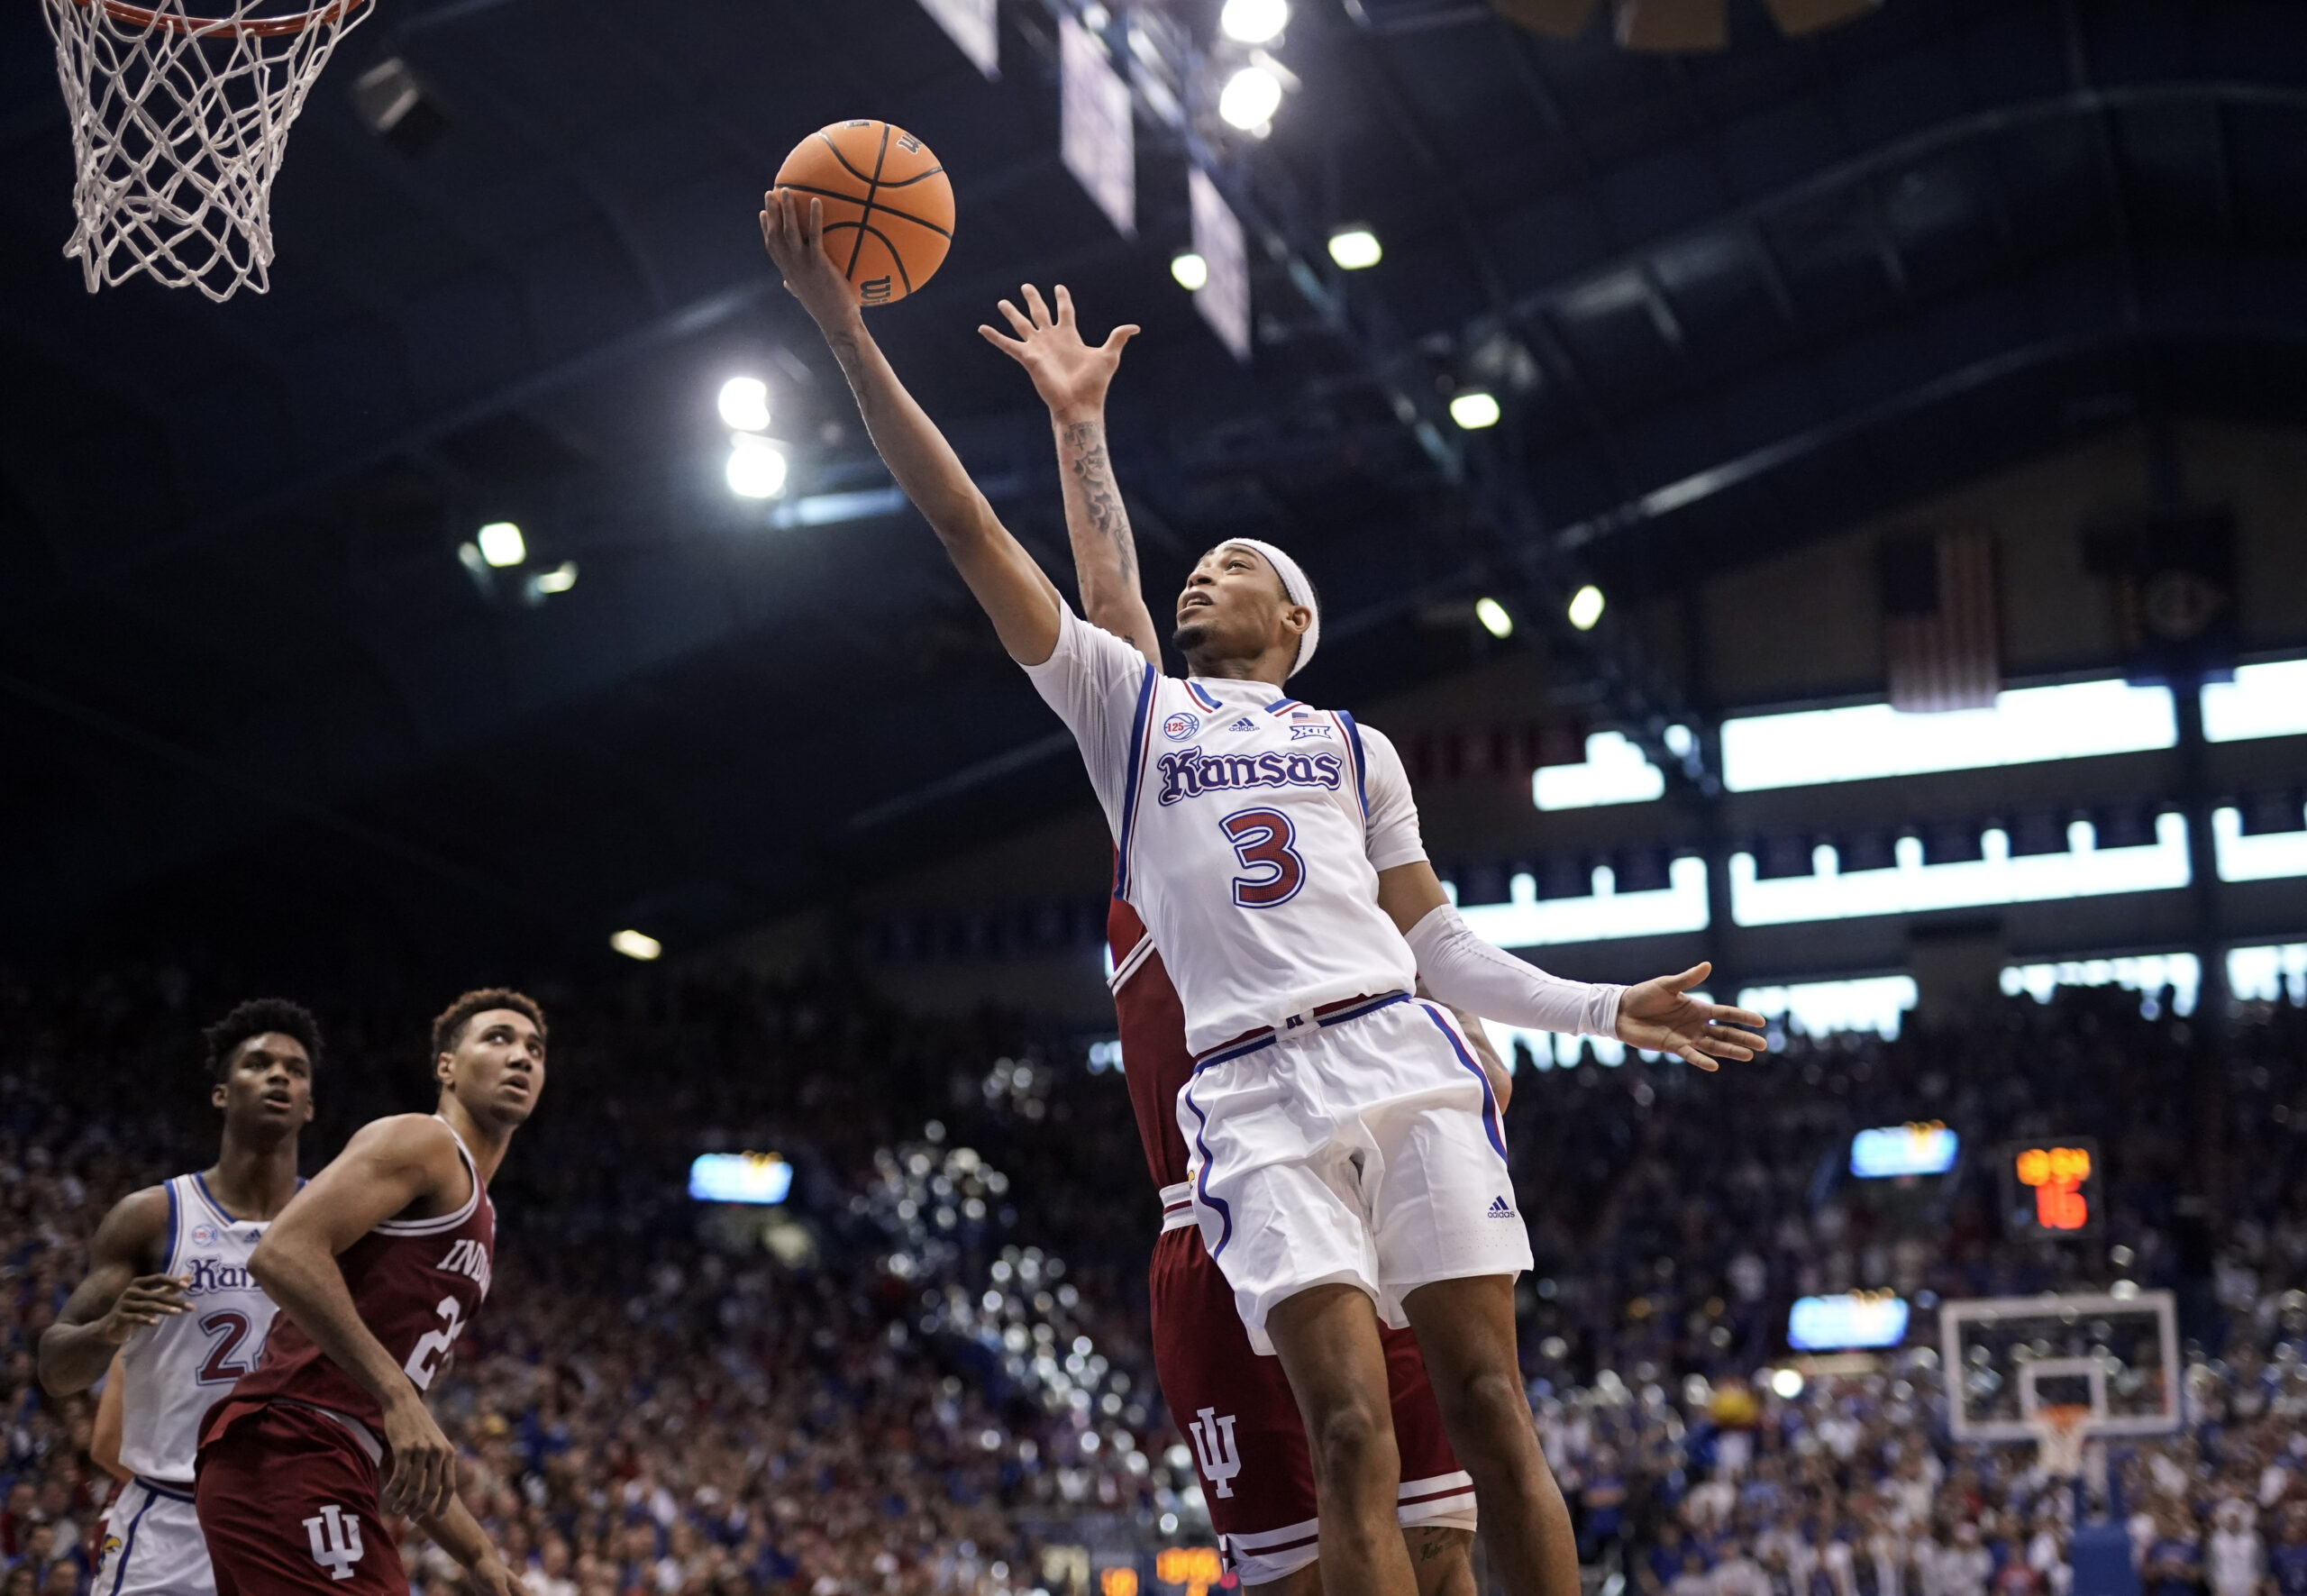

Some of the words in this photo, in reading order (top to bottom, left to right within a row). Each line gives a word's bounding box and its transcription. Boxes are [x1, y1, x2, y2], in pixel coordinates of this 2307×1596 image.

[1166, 722, 1185, 733] 125
[1157, 745, 1342, 807] Kansas
[1218, 807, 1306, 908] 3
[1487, 1210, 1516, 1218] adidas
